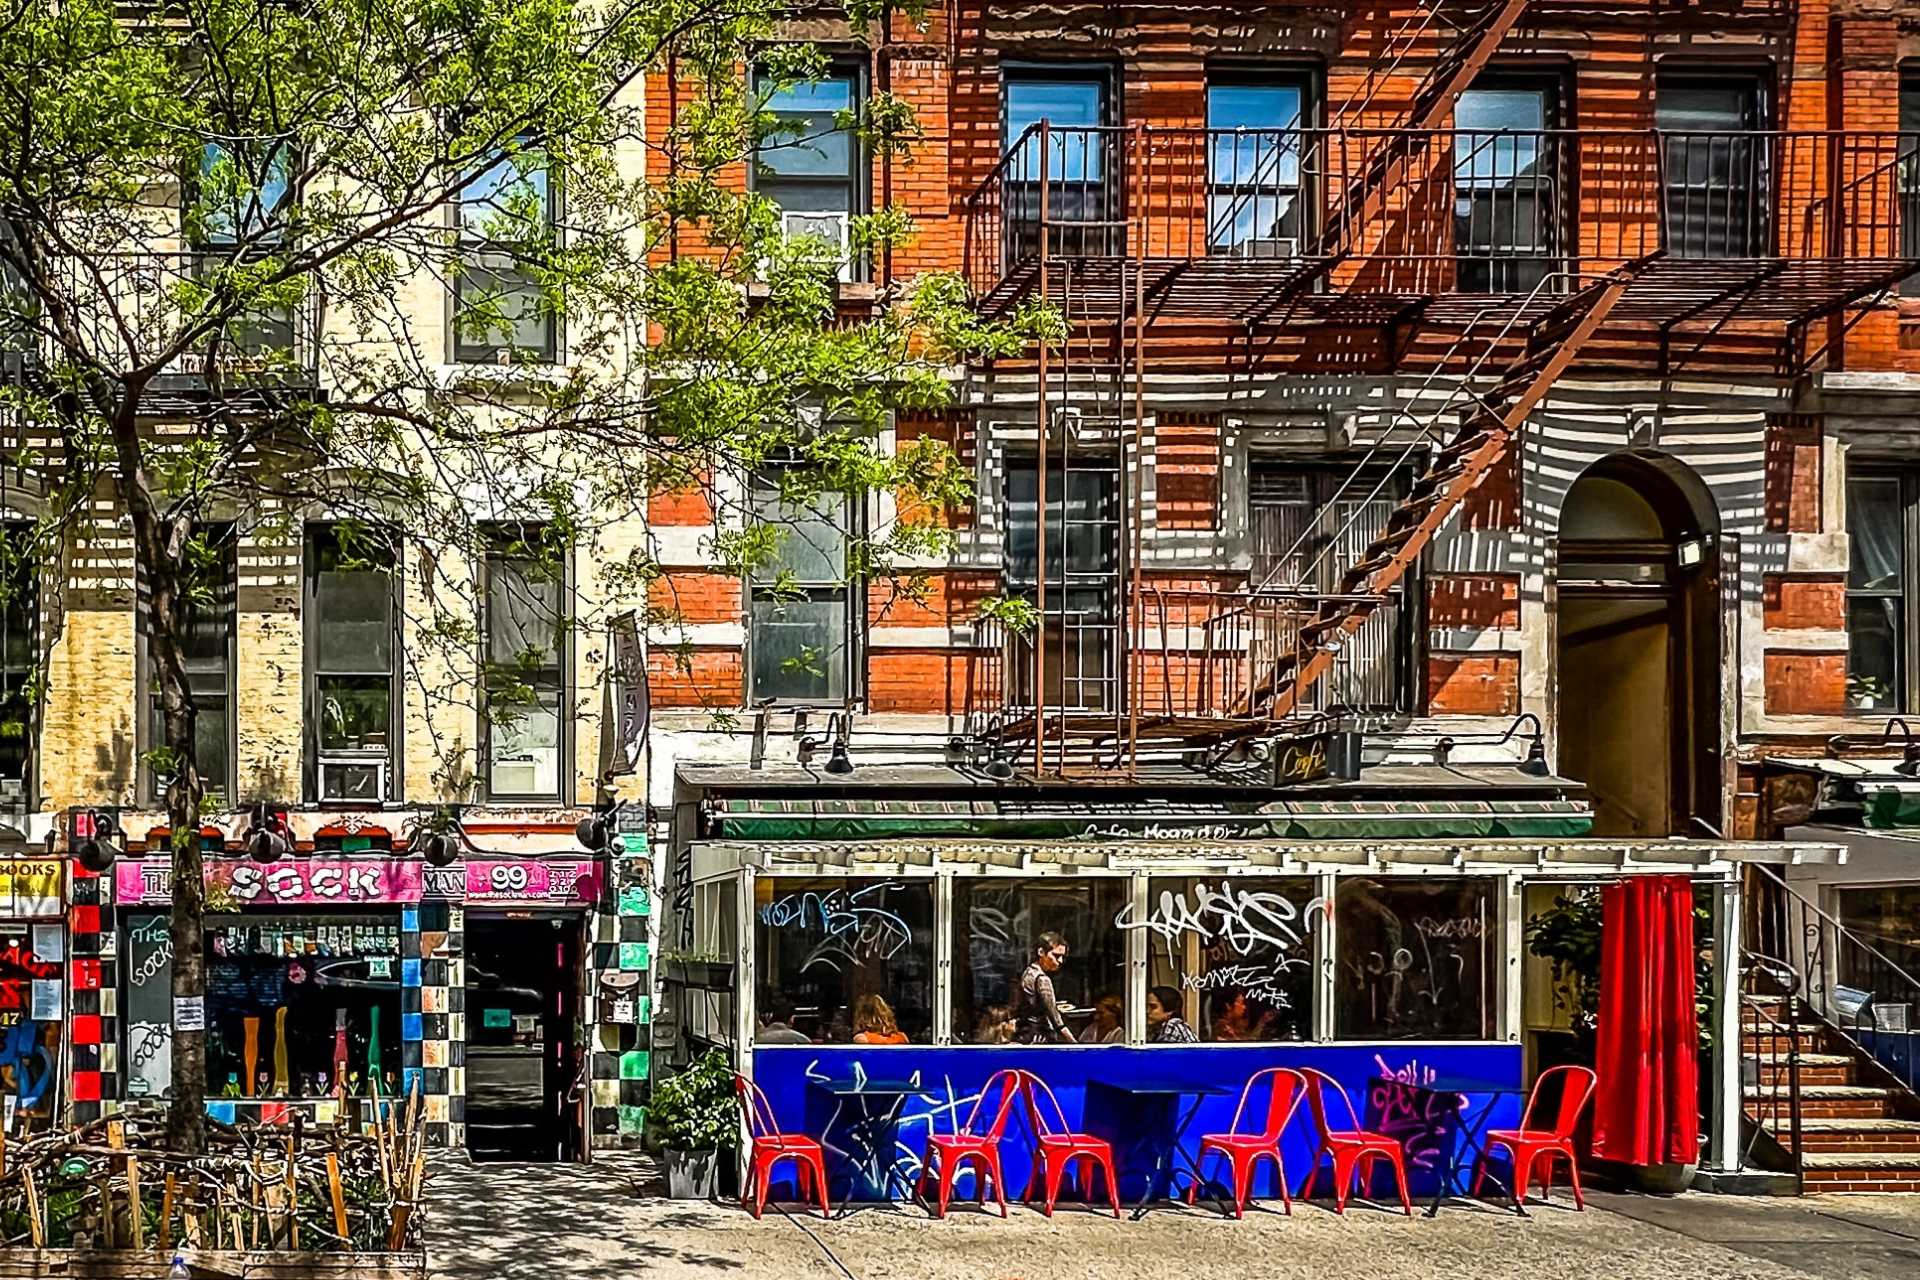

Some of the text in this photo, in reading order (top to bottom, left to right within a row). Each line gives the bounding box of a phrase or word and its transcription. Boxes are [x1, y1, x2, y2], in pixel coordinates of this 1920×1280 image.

[142, 866, 467, 899] TH SOCK MAN
[491, 864, 528, 890] 99
